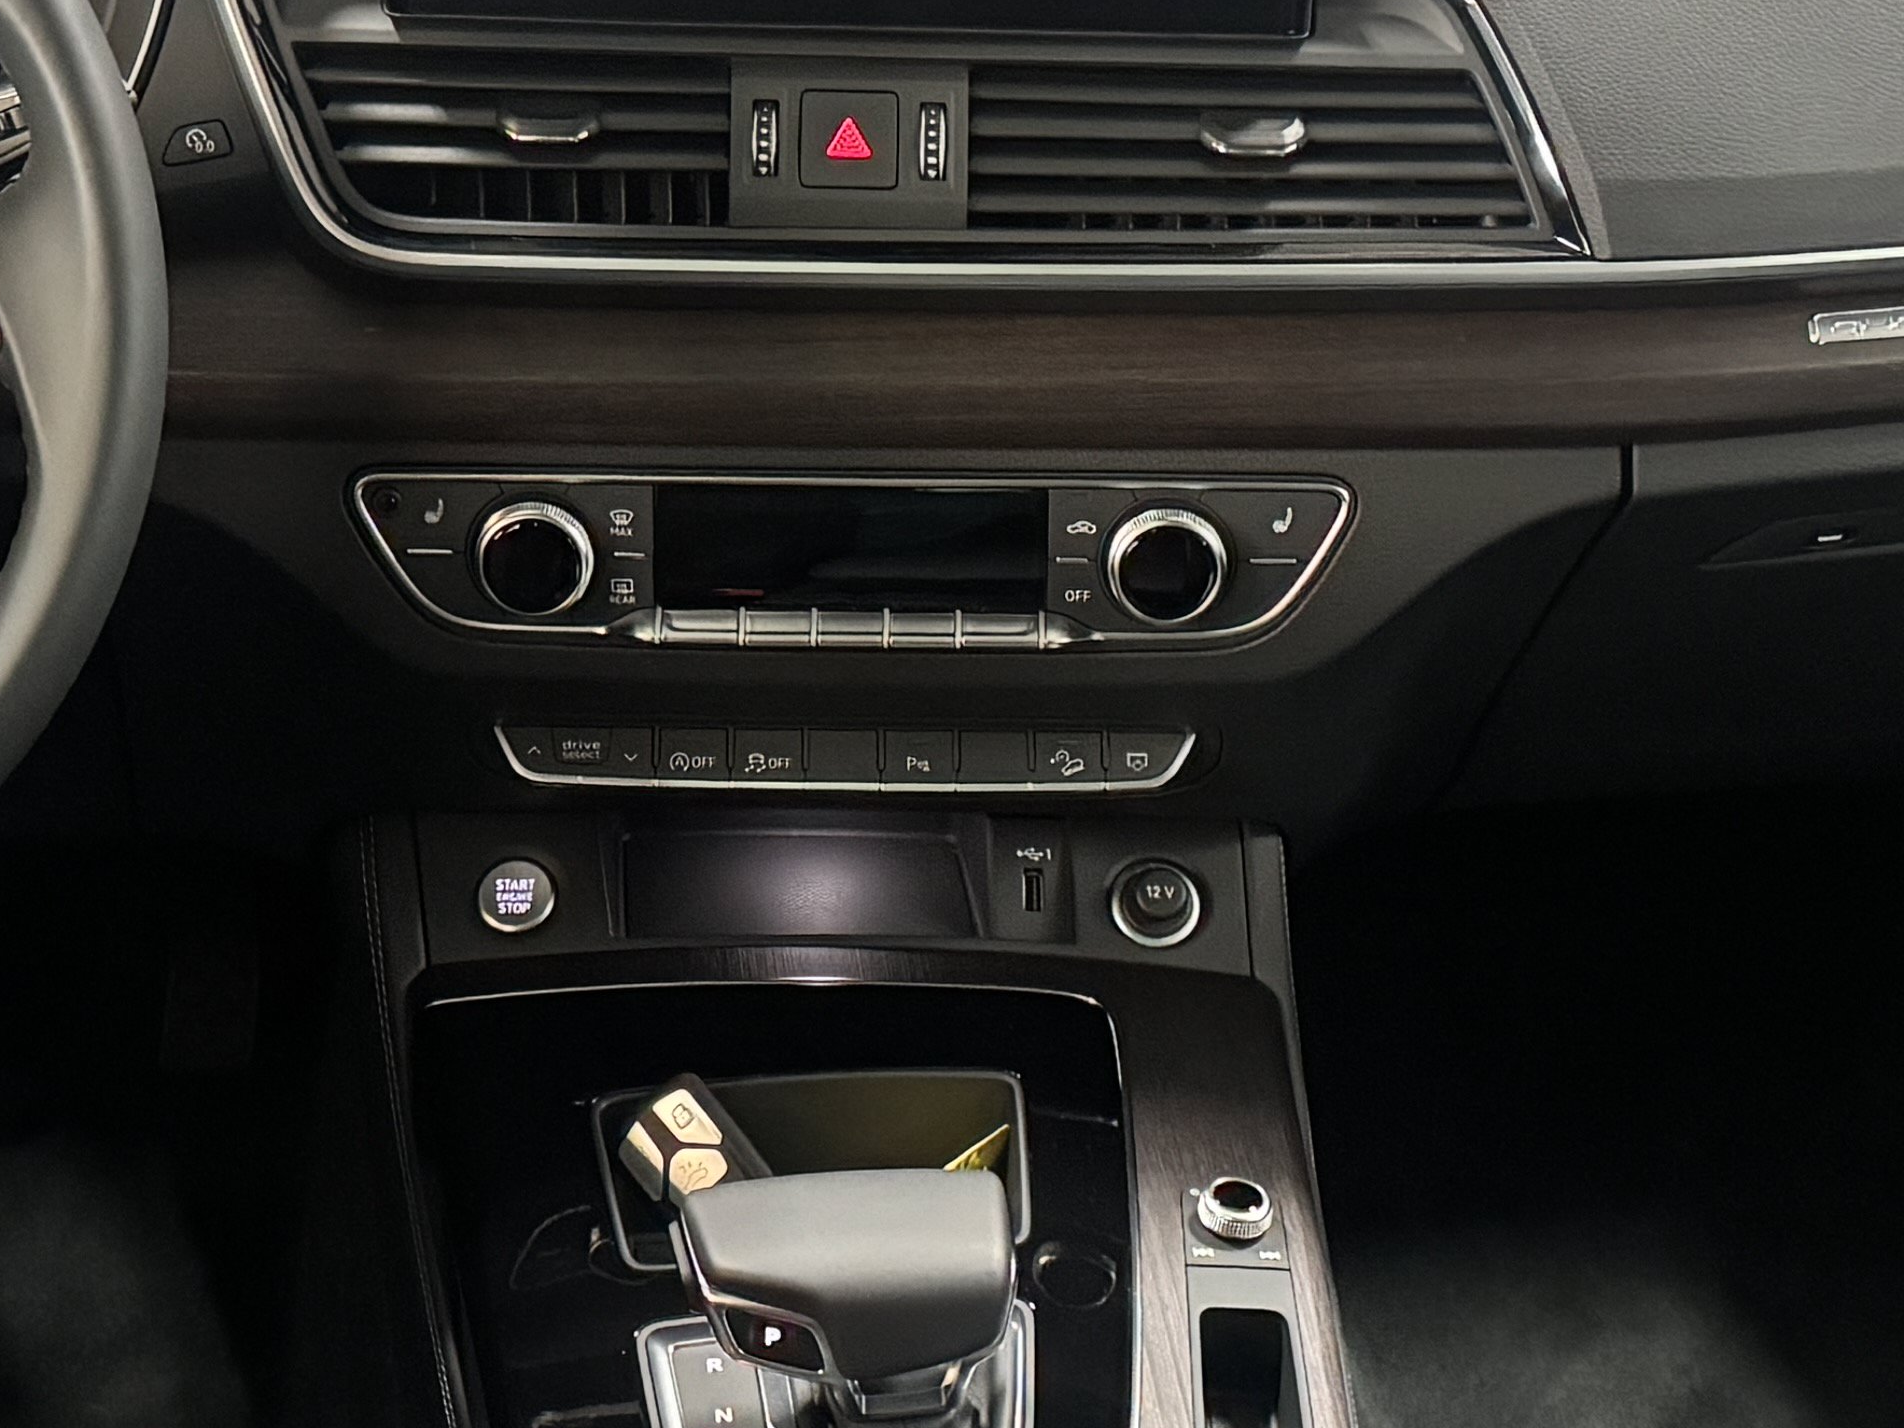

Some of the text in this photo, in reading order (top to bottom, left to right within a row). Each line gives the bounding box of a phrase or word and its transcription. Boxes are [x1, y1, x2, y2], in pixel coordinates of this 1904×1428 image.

[609, 526, 633, 537] MAX
[1064, 589, 1092, 603] OFF
[562, 740, 601, 751] drive
[562, 750, 601, 760] select
[691, 756, 716, 769] OFF
[768, 757, 793, 770] OFF
[495, 878, 536, 891] START
[496, 892, 533, 902] ENGINE
[1146, 885, 1176, 900] 12 V
[497, 902, 532, 915] STOP
[764, 1326, 782, 1347] P
[706, 1357, 724, 1373] R
[714, 1407, 734, 1424] N
